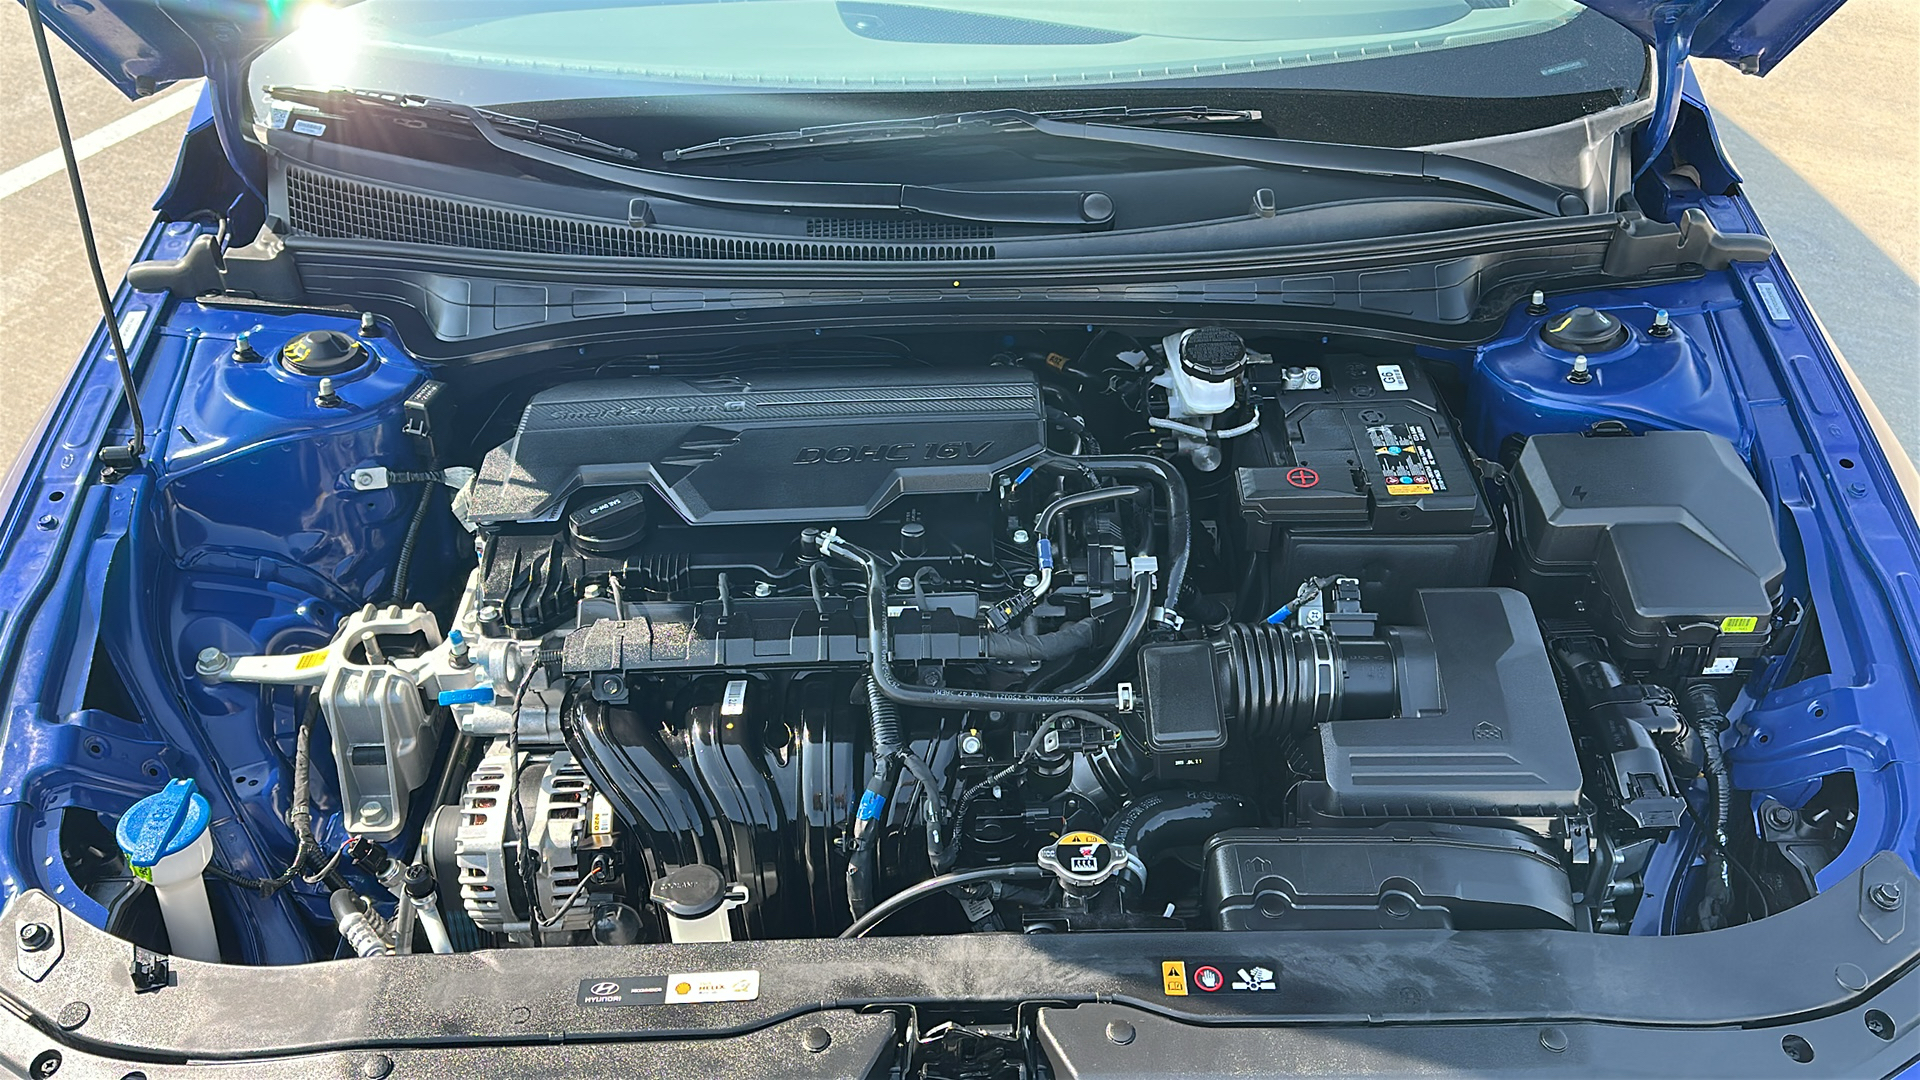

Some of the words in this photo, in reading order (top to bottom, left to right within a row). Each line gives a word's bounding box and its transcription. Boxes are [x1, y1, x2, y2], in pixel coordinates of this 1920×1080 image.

[550, 404, 718, 421] Smartstream
[793, 442, 916, 465] DOHC
[923, 440, 995, 460] 16V
[584, 995, 622, 1003] HYUNDAI
